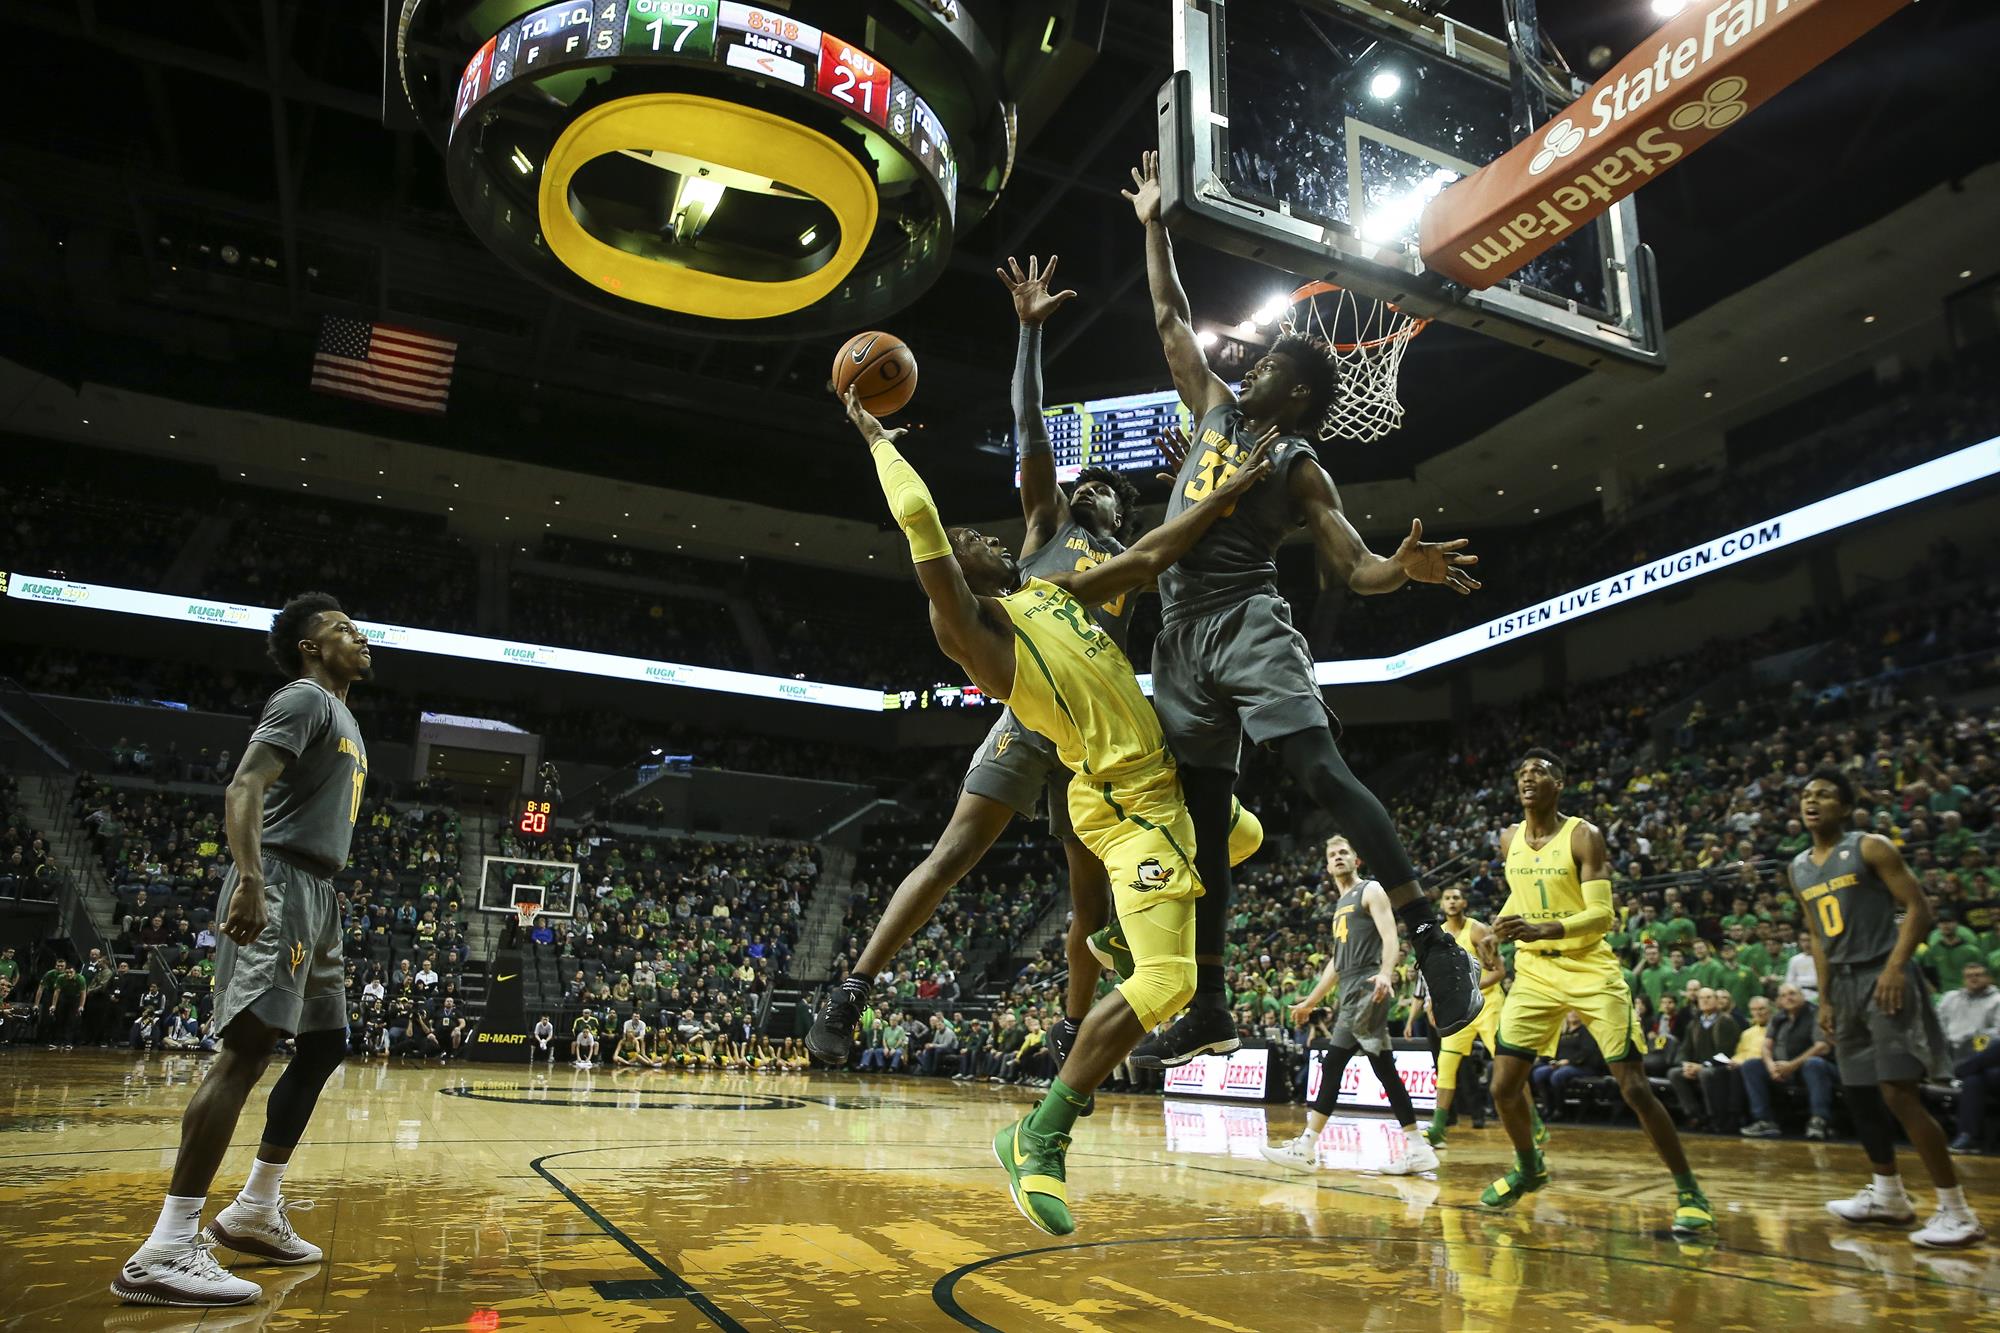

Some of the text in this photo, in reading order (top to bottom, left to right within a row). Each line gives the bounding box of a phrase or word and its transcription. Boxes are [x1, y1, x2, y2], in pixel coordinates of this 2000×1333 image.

[600, 3, 617, 23] 4
[636, 0, 710, 18] Oregon
[645, 17, 700, 53] 17
[748, 11, 800, 41] 8:18
[500, 33, 512, 53] 4
[527, 30, 614, 65] F F 5
[495, 60, 507, 81] 6
[839, 47, 875, 77] ASU
[458, 69, 482, 119] 21
[831, 65, 873, 114] 21
[895, 90, 908, 110] 4
[893, 114, 906, 136] 6
[1459, 127, 1684, 271] StateFarm
[21, 583, 63, 597] KUGN
[1488, 523, 1781, 639] LISTEN LIVE AT KUGN.COM
[187, 605, 225, 618] KUGN
[503, 647, 536, 659] KUGN
[645, 666, 676, 678] KUGN
[779, 684, 807, 695] KUGN
[527, 801, 550, 814] 8:18
[521, 812, 546, 832] 20
[1534, 879, 1549, 910] 1
[1817, 895, 1844, 938] 0
[1219, 1061, 1264, 1090] JERRY'S
